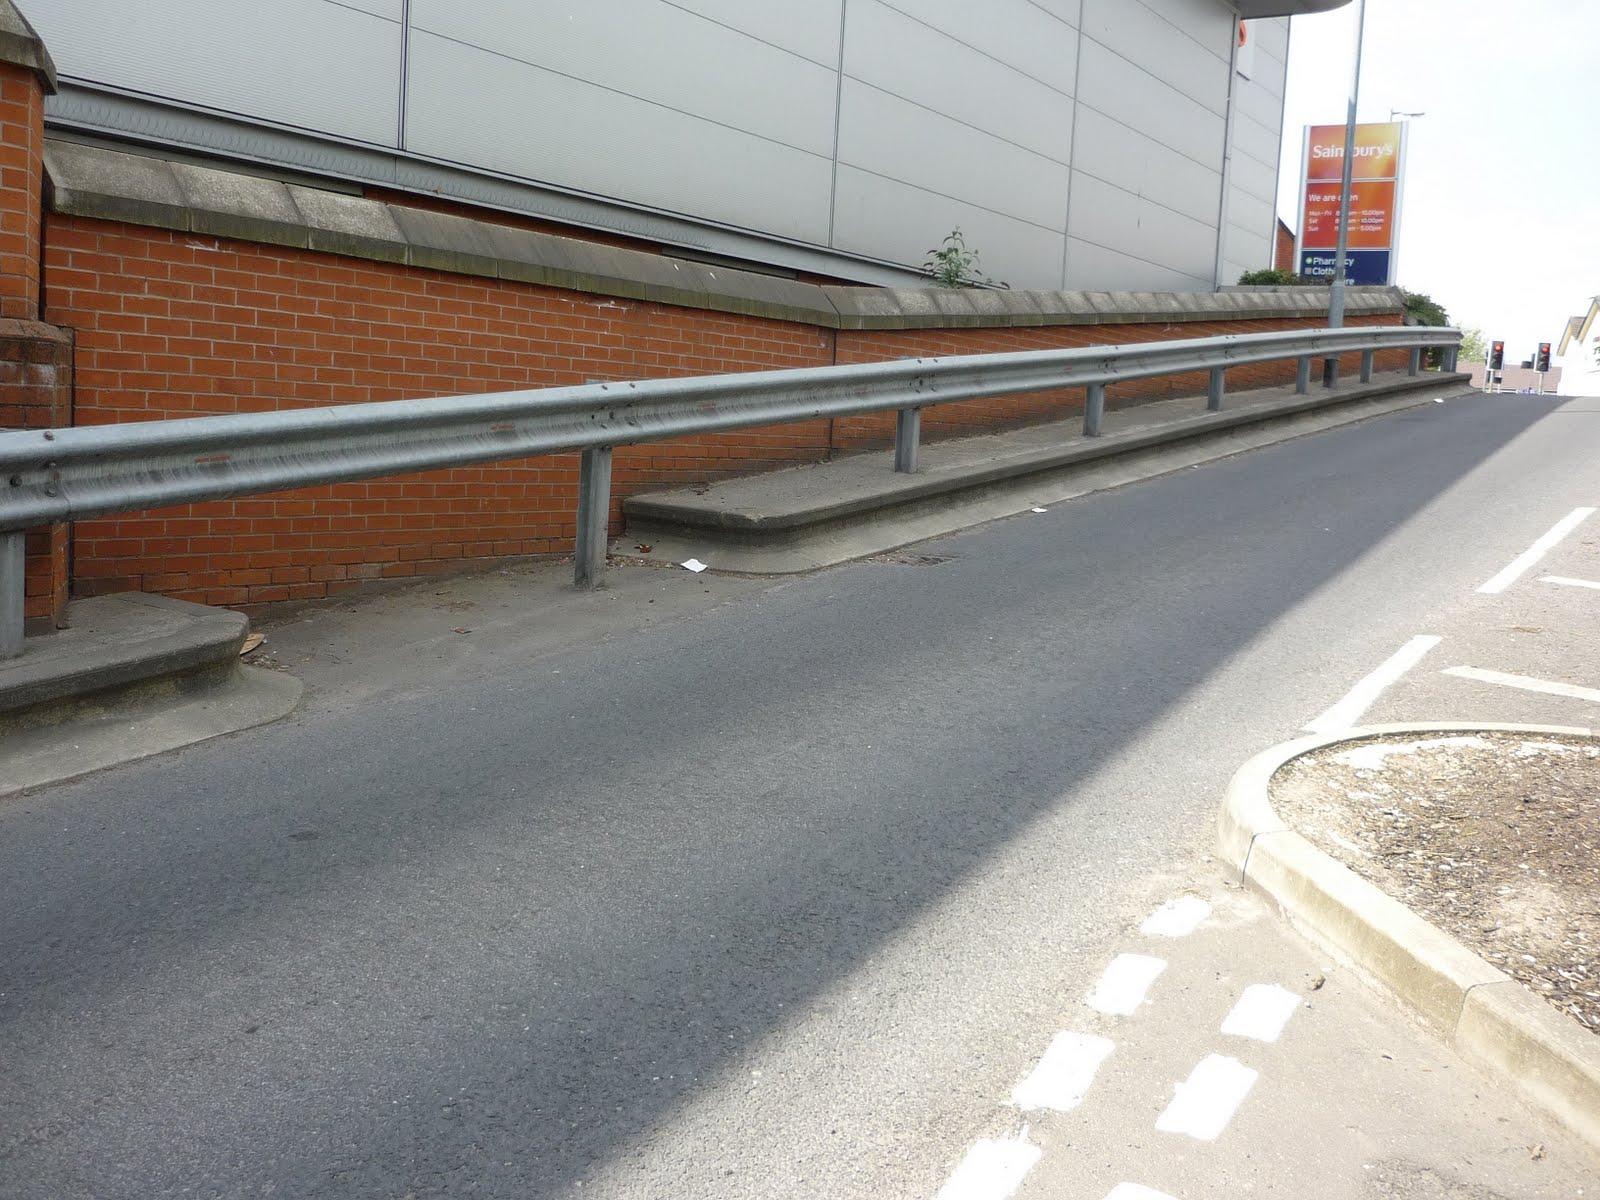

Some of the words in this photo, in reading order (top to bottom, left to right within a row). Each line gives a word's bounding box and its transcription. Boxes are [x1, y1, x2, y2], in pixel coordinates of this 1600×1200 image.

[1312, 144, 1393, 160] Sainbury's
[1308, 194, 1321, 202] We
[1338, 194, 1359, 202] oen
[1312, 257, 1355, 266] Pharcy
[1312, 267, 1346, 276] Clothi
